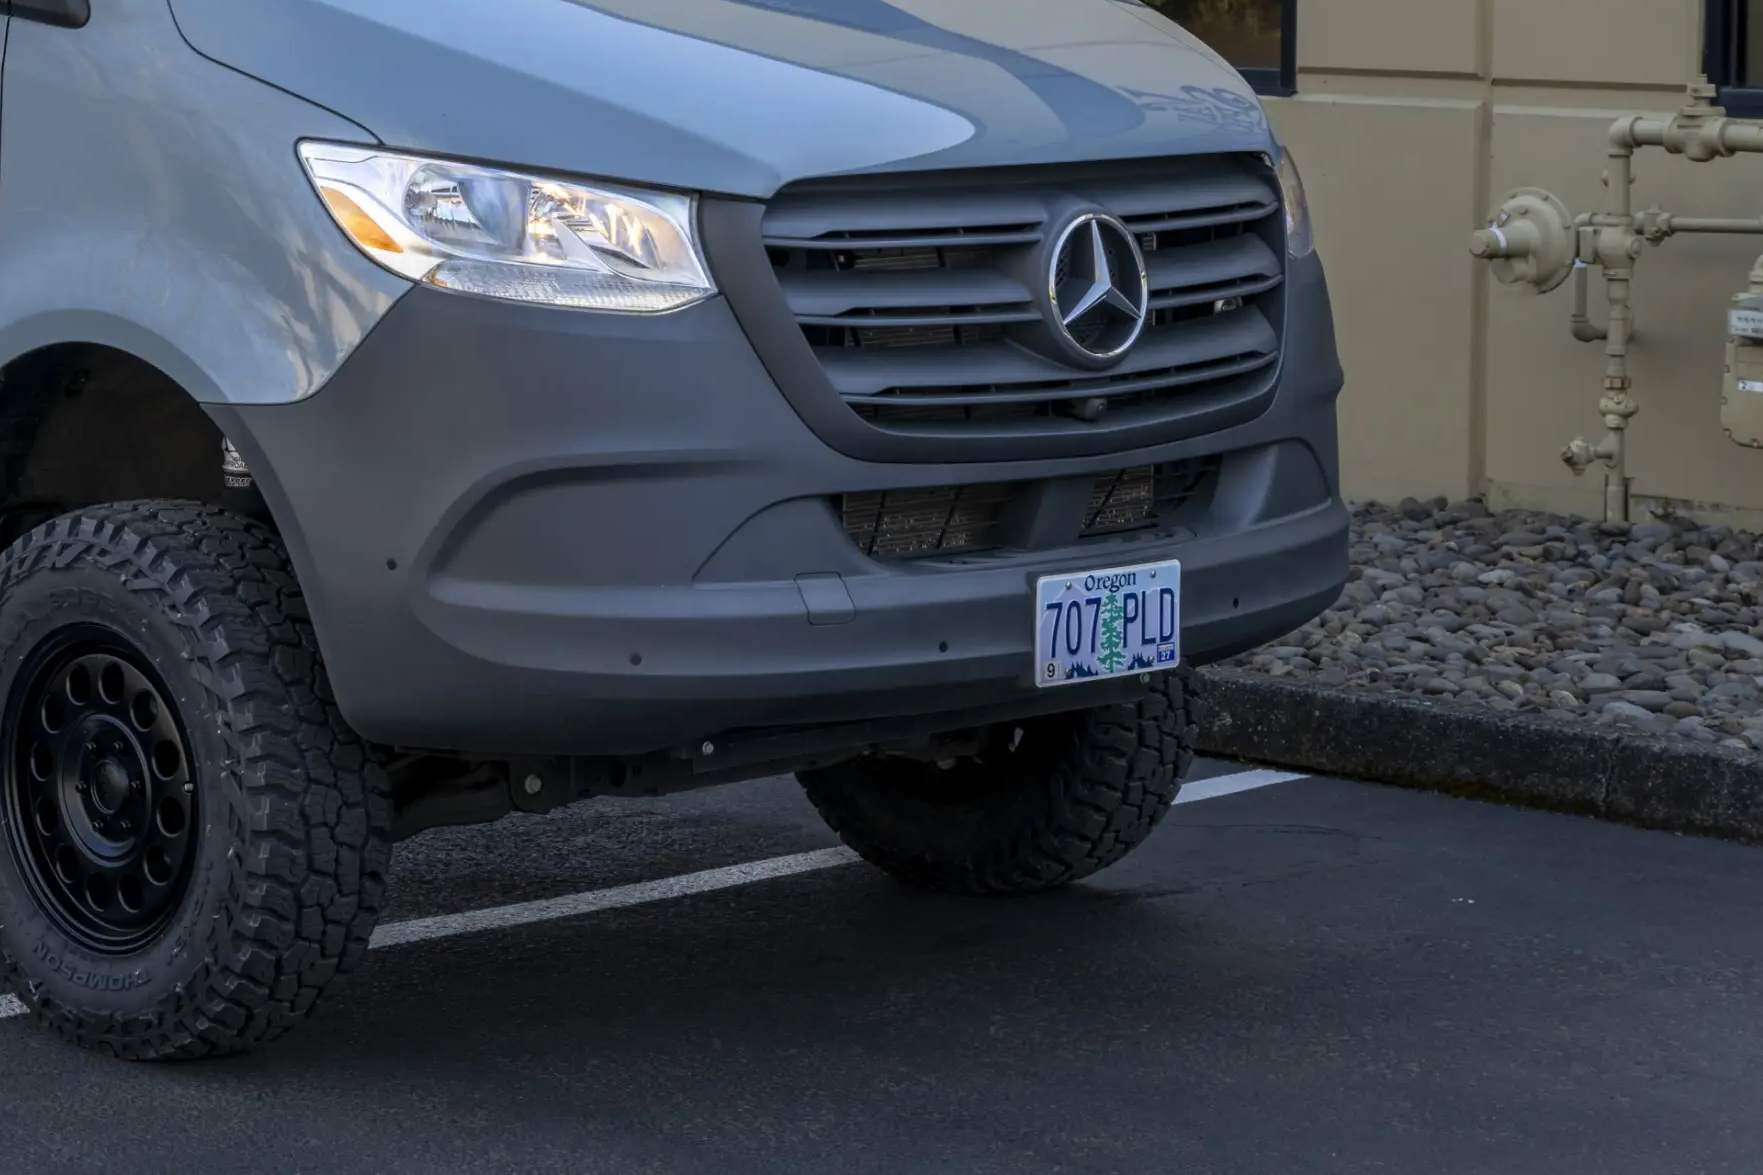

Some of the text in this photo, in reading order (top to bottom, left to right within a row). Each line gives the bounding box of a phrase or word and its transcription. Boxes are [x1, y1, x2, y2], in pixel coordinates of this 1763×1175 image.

[1084, 571, 1137, 593] Oregon
[1046, 587, 1175, 659] 707 PLD
[1160, 651, 1171, 661] 27
[1046, 662, 1055, 678] 9
[32, 941, 152, 991] THOMPSON
